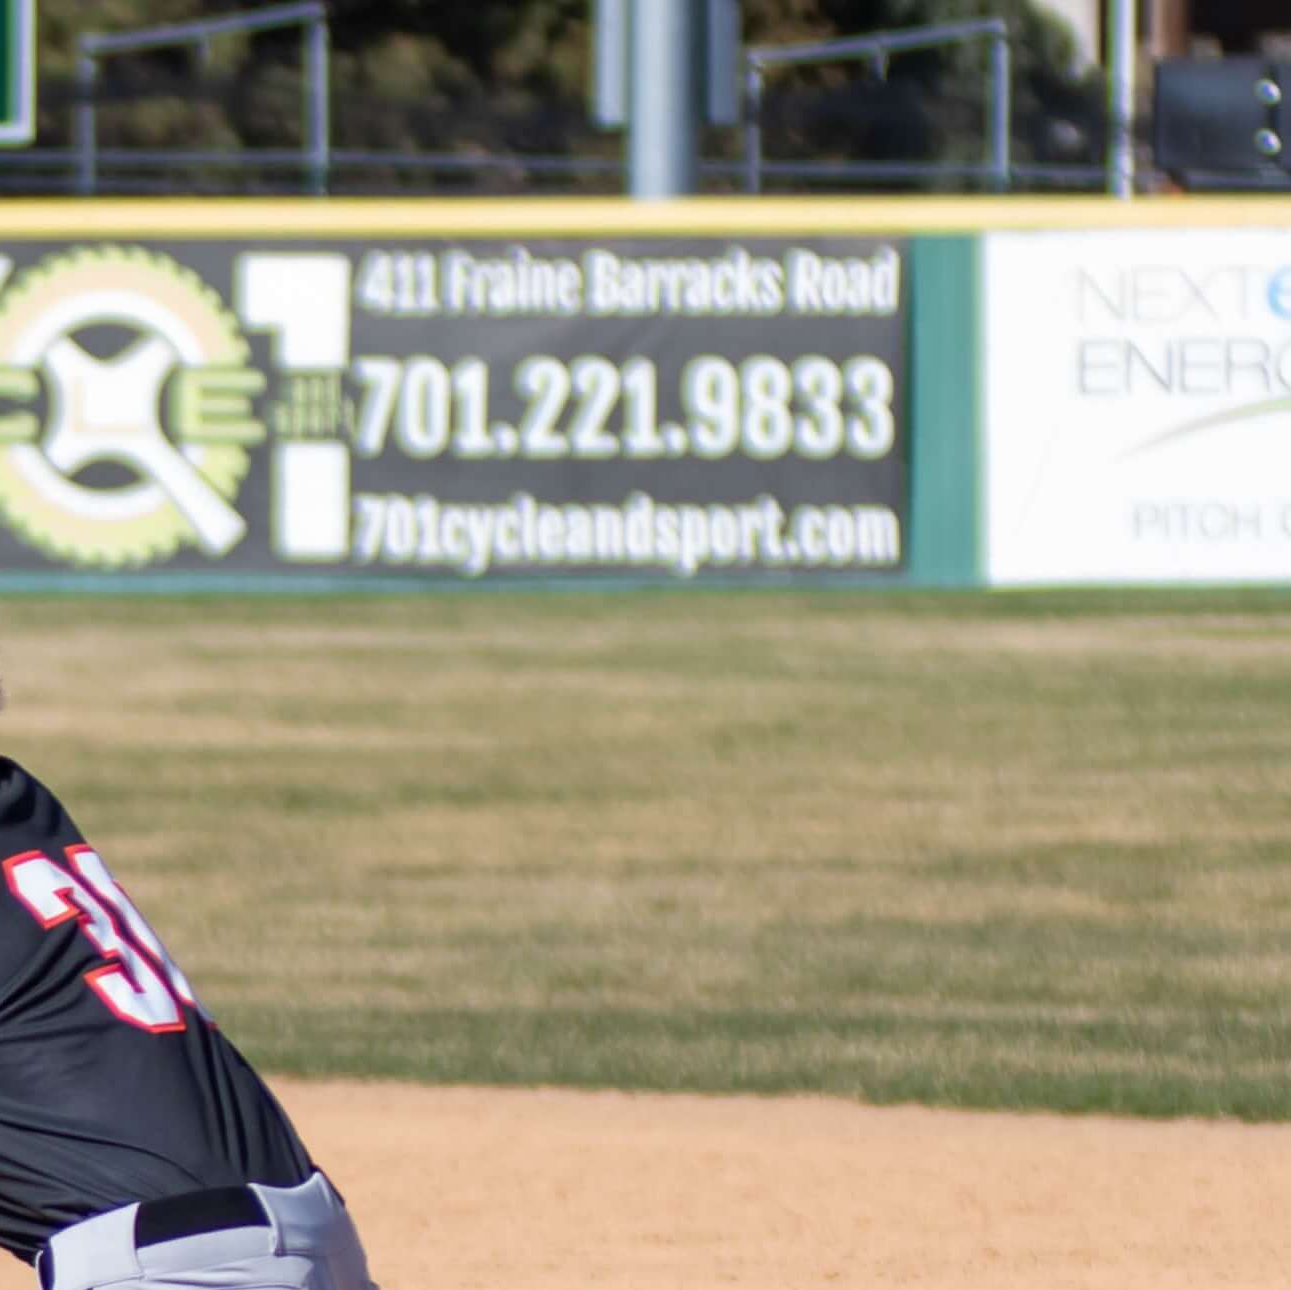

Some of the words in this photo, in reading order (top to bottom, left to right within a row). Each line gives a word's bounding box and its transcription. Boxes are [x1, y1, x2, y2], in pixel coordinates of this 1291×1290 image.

[359, 249, 440, 315] 411
[443, 245, 582, 316] Fraine
[583, 247, 786, 316] Barracks
[786, 246, 901, 316] Road
[350, 355, 897, 459] 701.221.9833
[355, 492, 903, 577] 701cycleandsport.com
